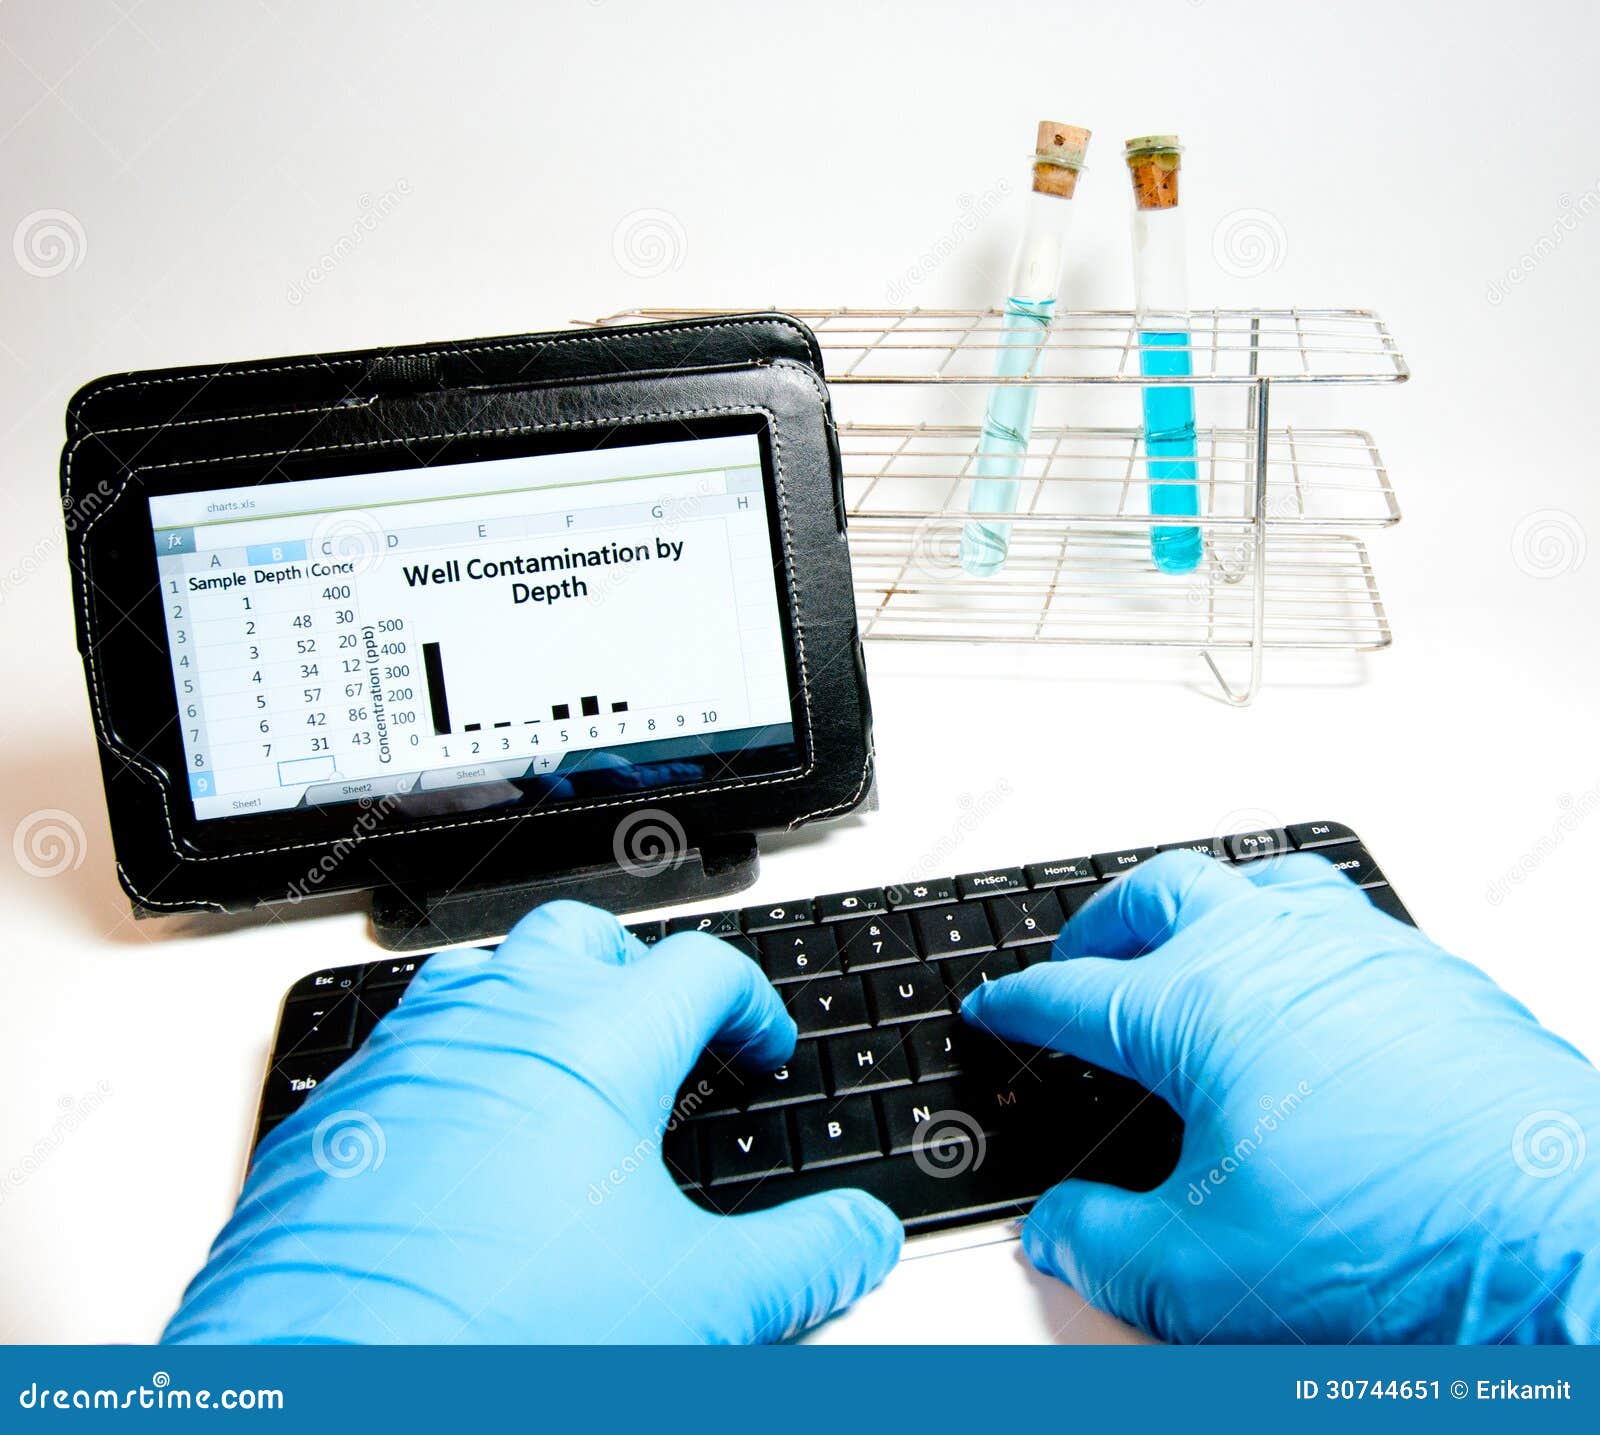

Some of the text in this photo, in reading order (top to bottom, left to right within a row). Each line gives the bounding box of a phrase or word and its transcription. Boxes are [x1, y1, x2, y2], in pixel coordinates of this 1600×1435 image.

[207, 499, 255, 513] charts.xls
[210, 496, 749, 568] A B C D E F G H
[402, 537, 684, 588] Well Contamination by
[170, 581, 180, 594] 1
[188, 573, 247, 593] Sample
[254, 565, 302, 585] Depth
[512, 576, 588, 605] Depth
[173, 585, 351, 619] 2 1 400
[177, 609, 354, 644] 3 2 48 30
[378, 618, 404, 633] 500
[179, 634, 357, 668] 4 3 52 20
[380, 642, 406, 656] 400
[184, 659, 361, 693] 5 4 34 12
[384, 665, 410, 680] 300
[187, 683, 363, 718] 6 5 57 67
[361, 625, 392, 764] Concentration (ppb)
[388, 688, 414, 703] 200
[190, 707, 368, 743] 7 6 42 86
[391, 711, 416, 726] 100
[410, 734, 420, 747] 0
[442, 710, 718, 758] 1 2 3 4 5 6 7 8 9 10
[194, 731, 371, 767] 8 7 31 43
[197, 778, 208, 793] 9
[342, 783, 373, 795] Sheet2
[232, 798, 262, 810] Sheet1
[1311, 825, 1330, 835] Del
[1243, 836, 1274, 847] Pg Dn
[1117, 855, 1138, 865] End
[1045, 864, 1076, 876] Home
[974, 875, 1008, 886] PrtScn
[1024, 918, 1036, 930] 9
[950, 930, 961, 942] 8
[873, 941, 883, 953] 7
[796, 954, 808, 966] 6
[315, 976, 334, 986] Esc
[899, 983, 914, 998] U
[819, 996, 833, 1012] Y
[944, 1037, 952, 1052] J
[857, 1050, 874, 1067] H
[774, 1065, 789, 1080] G
[290, 1076, 317, 1092] Tab
[996, 1090, 1017, 1107] M
[912, 1105, 931, 1123] N
[827, 1121, 843, 1138] B
[737, 1135, 754, 1153] V
